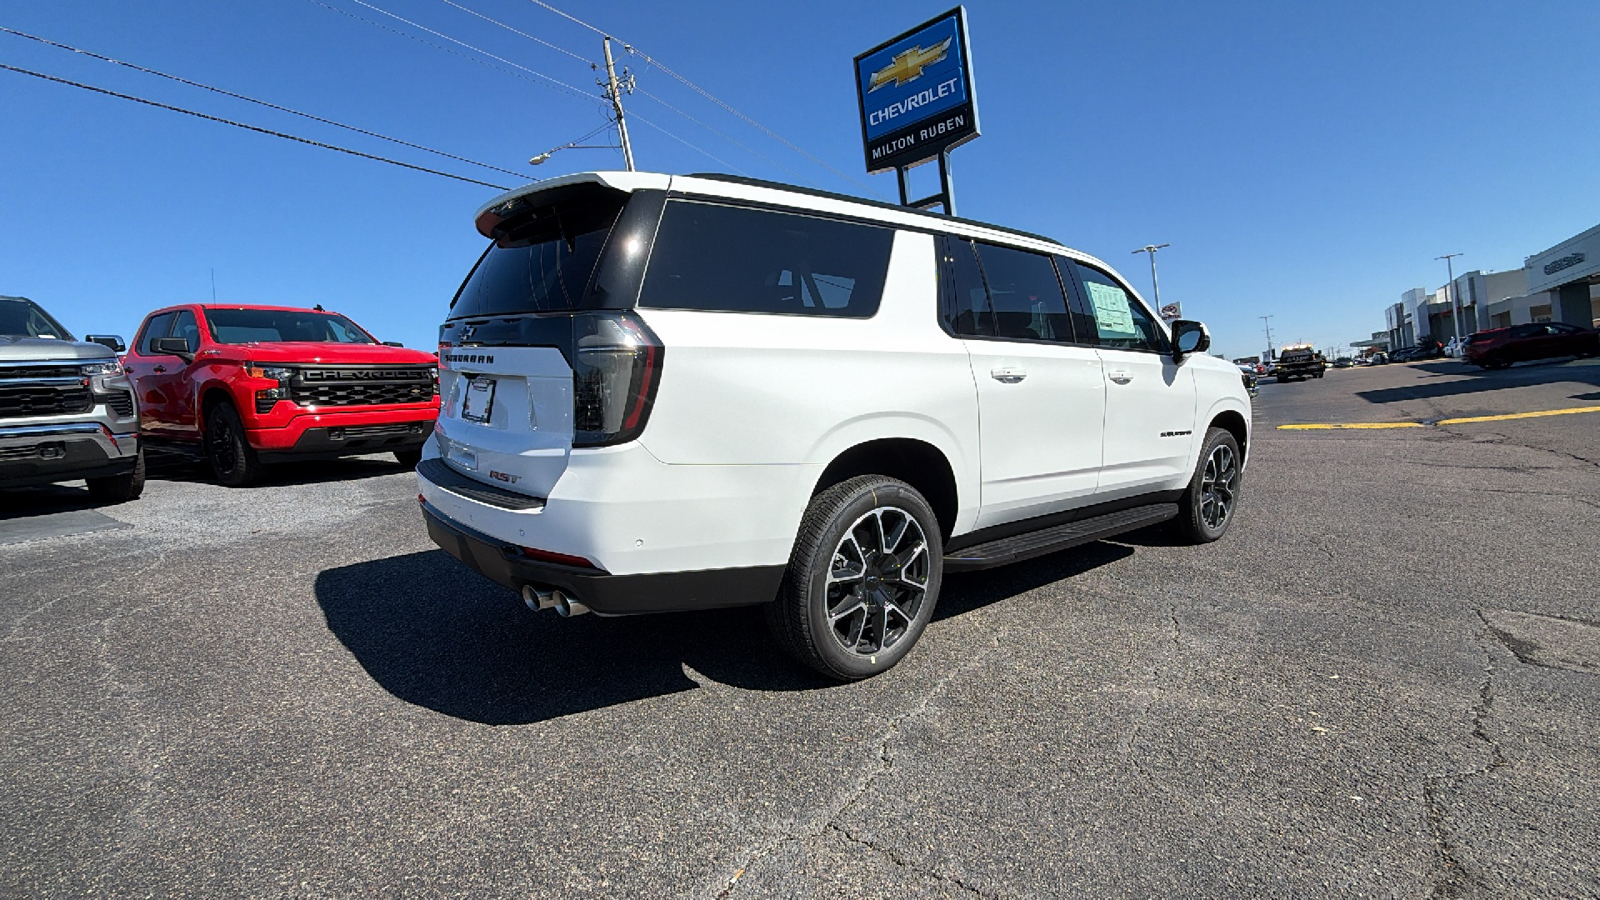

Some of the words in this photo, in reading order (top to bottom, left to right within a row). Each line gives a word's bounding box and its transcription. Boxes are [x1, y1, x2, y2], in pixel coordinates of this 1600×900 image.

[869, 78, 958, 127] CHEVROLET
[872, 134, 915, 160] MILTON
[920, 115, 964, 141] RUBEN
[445, 354, 494, 364] SUBURBAN
[489, 470, 522, 484] RST
